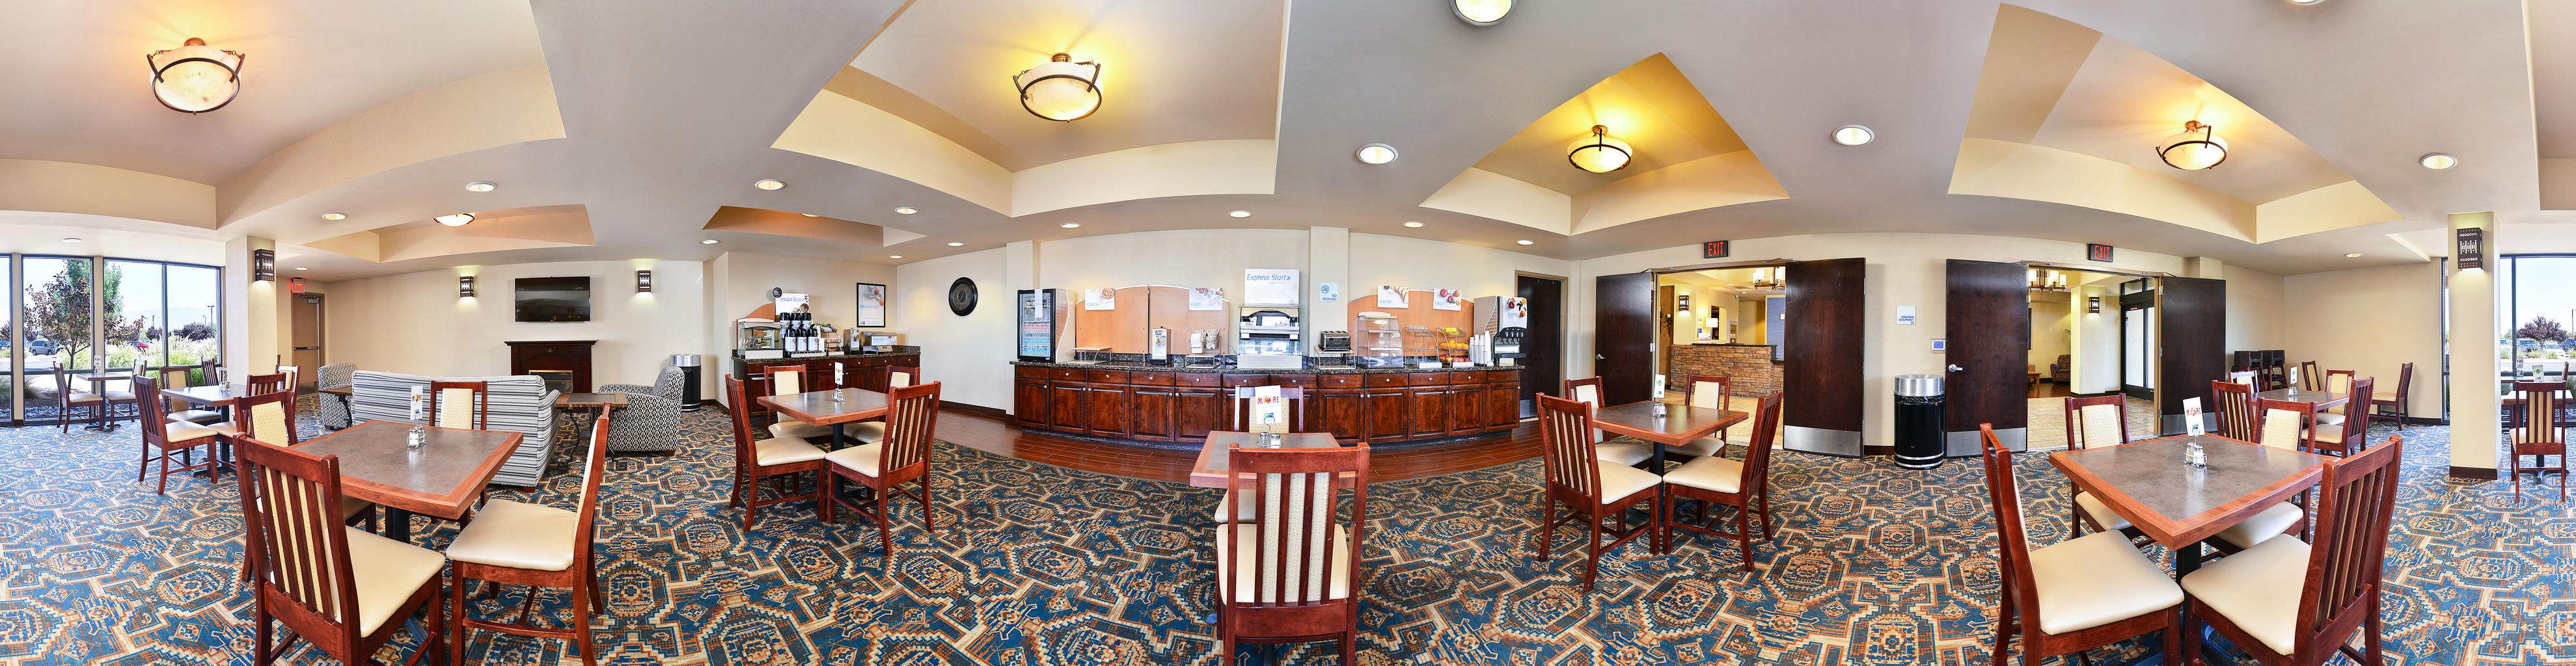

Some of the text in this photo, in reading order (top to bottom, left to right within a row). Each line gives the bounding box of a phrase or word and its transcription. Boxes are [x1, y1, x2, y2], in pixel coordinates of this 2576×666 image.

[1708, 241, 1723, 256] EXIT
[2094, 245, 2110, 260] EXIT
[294, 283, 303, 292] EXIT
[1257, 395, 1280, 405] MORE
